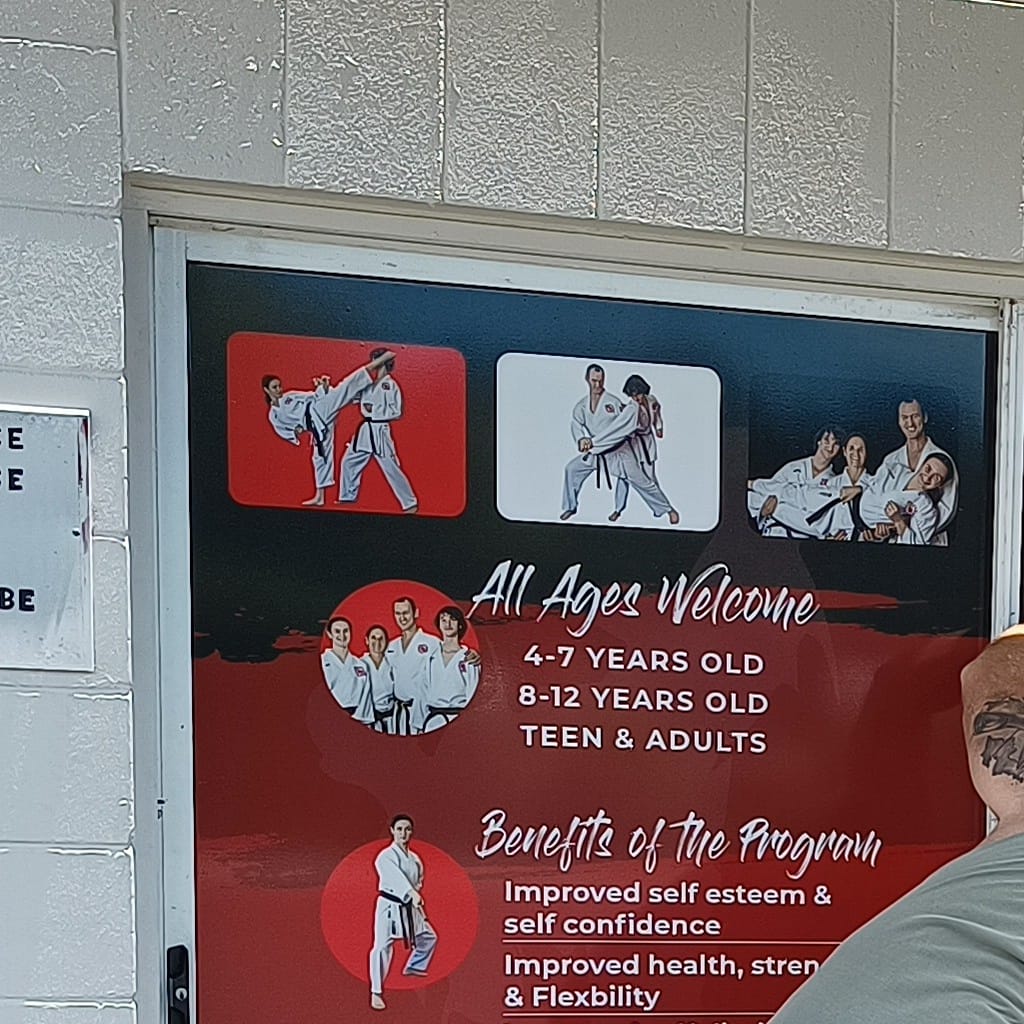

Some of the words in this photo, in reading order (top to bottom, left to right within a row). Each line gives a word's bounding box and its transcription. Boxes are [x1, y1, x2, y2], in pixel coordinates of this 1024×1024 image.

[0, 427, 24, 449] E
[0, 468, 24, 491] E
[466, 560, 535, 618] All
[536, 564, 641, 638] Ages
[657, 563, 820, 631] Welcome
[523, 645, 575, 668] 4-7
[585, 648, 689, 672] YEARS
[700, 652, 765, 676] OLD
[518, 685, 581, 709] 8-12
[591, 687, 694, 712] YEARS
[705, 691, 769, 715] OLD
[519, 724, 603, 749] TEEN
[615, 728, 634, 750] &
[645, 728, 767, 754] ADULTS
[475, 808, 613, 872] Benefits
[628, 818, 666, 874] of
[670, 811, 731, 867] the
[739, 817, 882, 880] Program
[505, 880, 640, 908] Improved
[648, 882, 700, 904] self
[705, 885, 806, 905] esteem
[814, 885, 832, 905] &
[504, 912, 557, 935] self
[562, 913, 721, 936] confidence
[504, 954, 639, 979] Improved
[649, 953, 744, 980] health,
[504, 987, 524, 1008] &
[533, 984, 660, 1011] Flexbility
